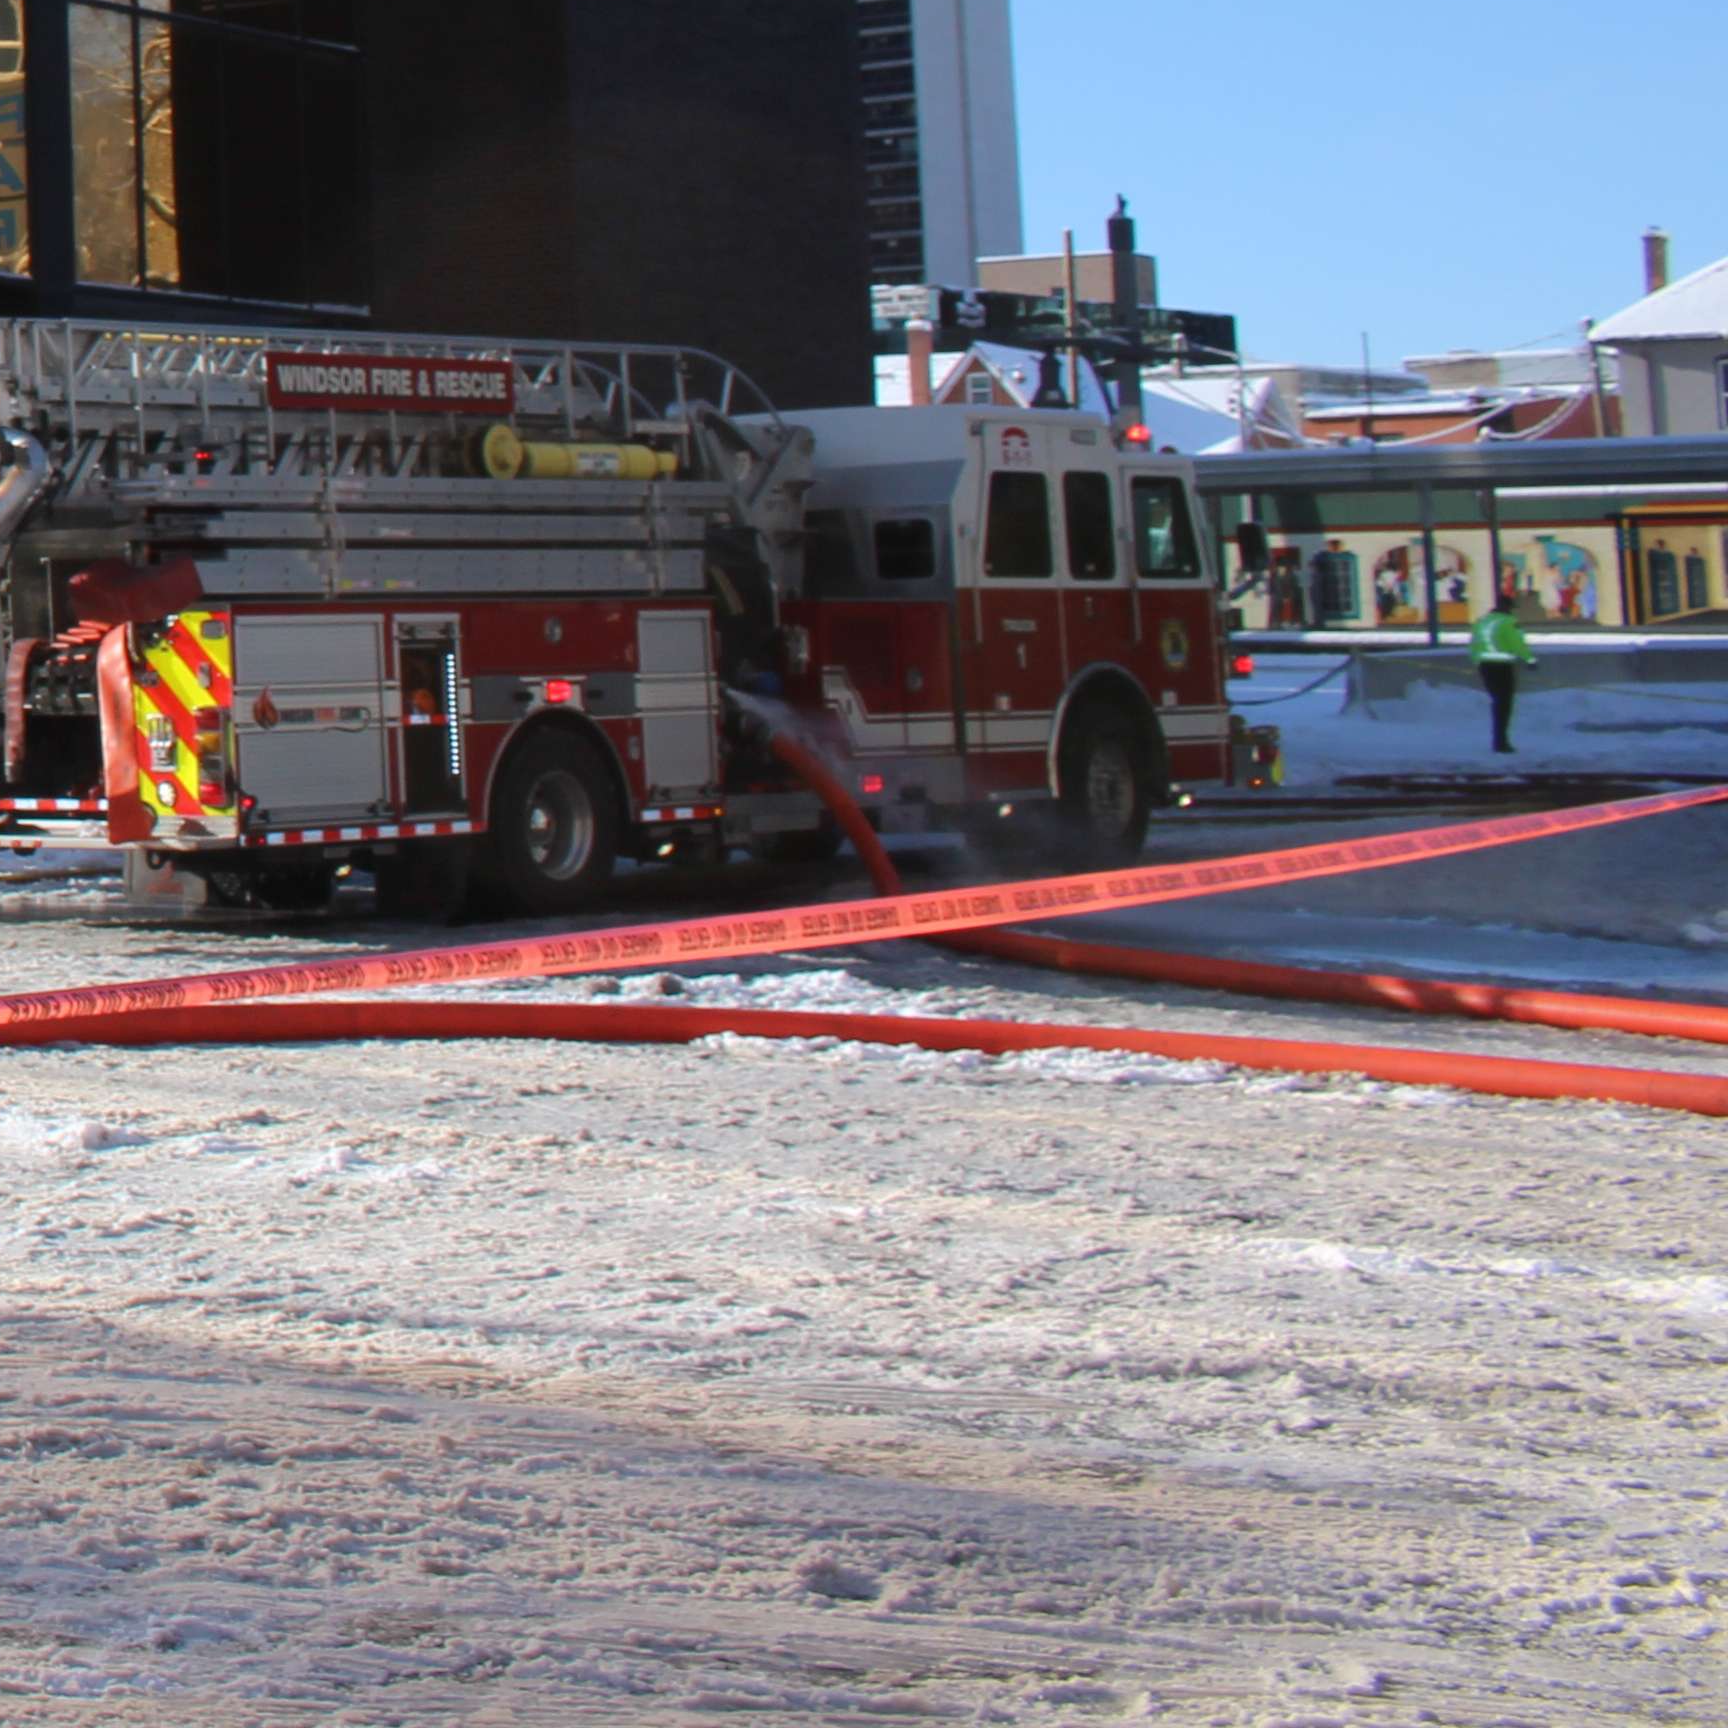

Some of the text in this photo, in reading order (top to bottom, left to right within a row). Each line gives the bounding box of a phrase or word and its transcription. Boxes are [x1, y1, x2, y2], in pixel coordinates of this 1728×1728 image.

[277, 364, 507, 399] WINDSOR FIRE & RESCUE
